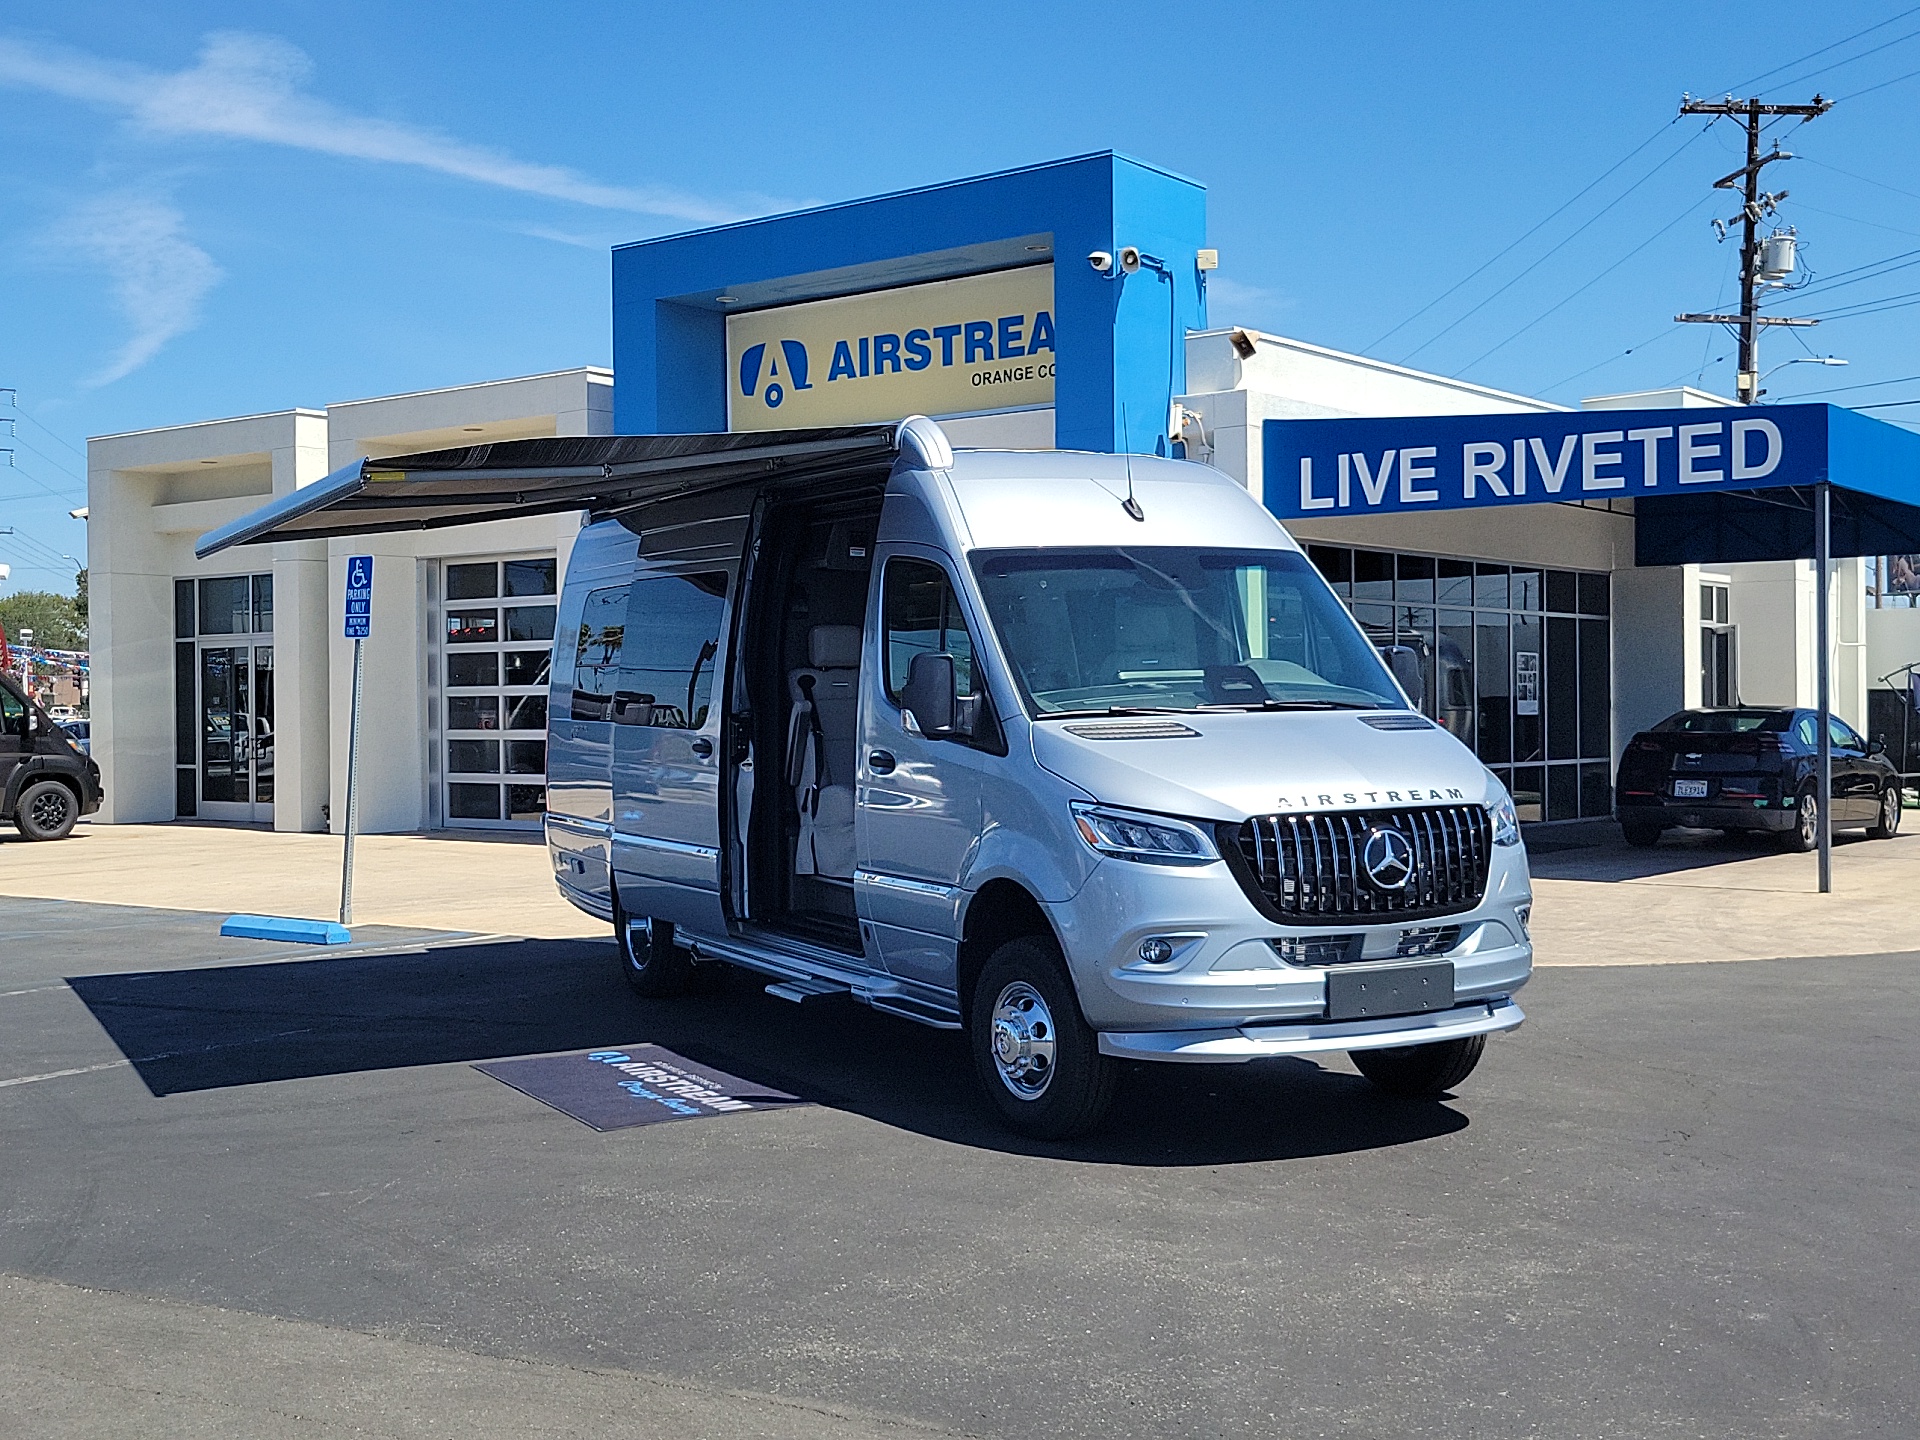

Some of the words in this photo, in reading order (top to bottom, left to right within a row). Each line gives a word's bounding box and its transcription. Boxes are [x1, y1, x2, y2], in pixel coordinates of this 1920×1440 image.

[971, 366, 1033, 387] ORANGE
[1300, 446, 1439, 510] LIVE
[1463, 417, 1783, 499] RIVETED
[347, 588, 370, 600] PARKING
[350, 601, 366, 613] ONLY
[1277, 788, 1464, 808] AIRSTREAM
[610, 1062, 754, 1112] AIRSTREAM
